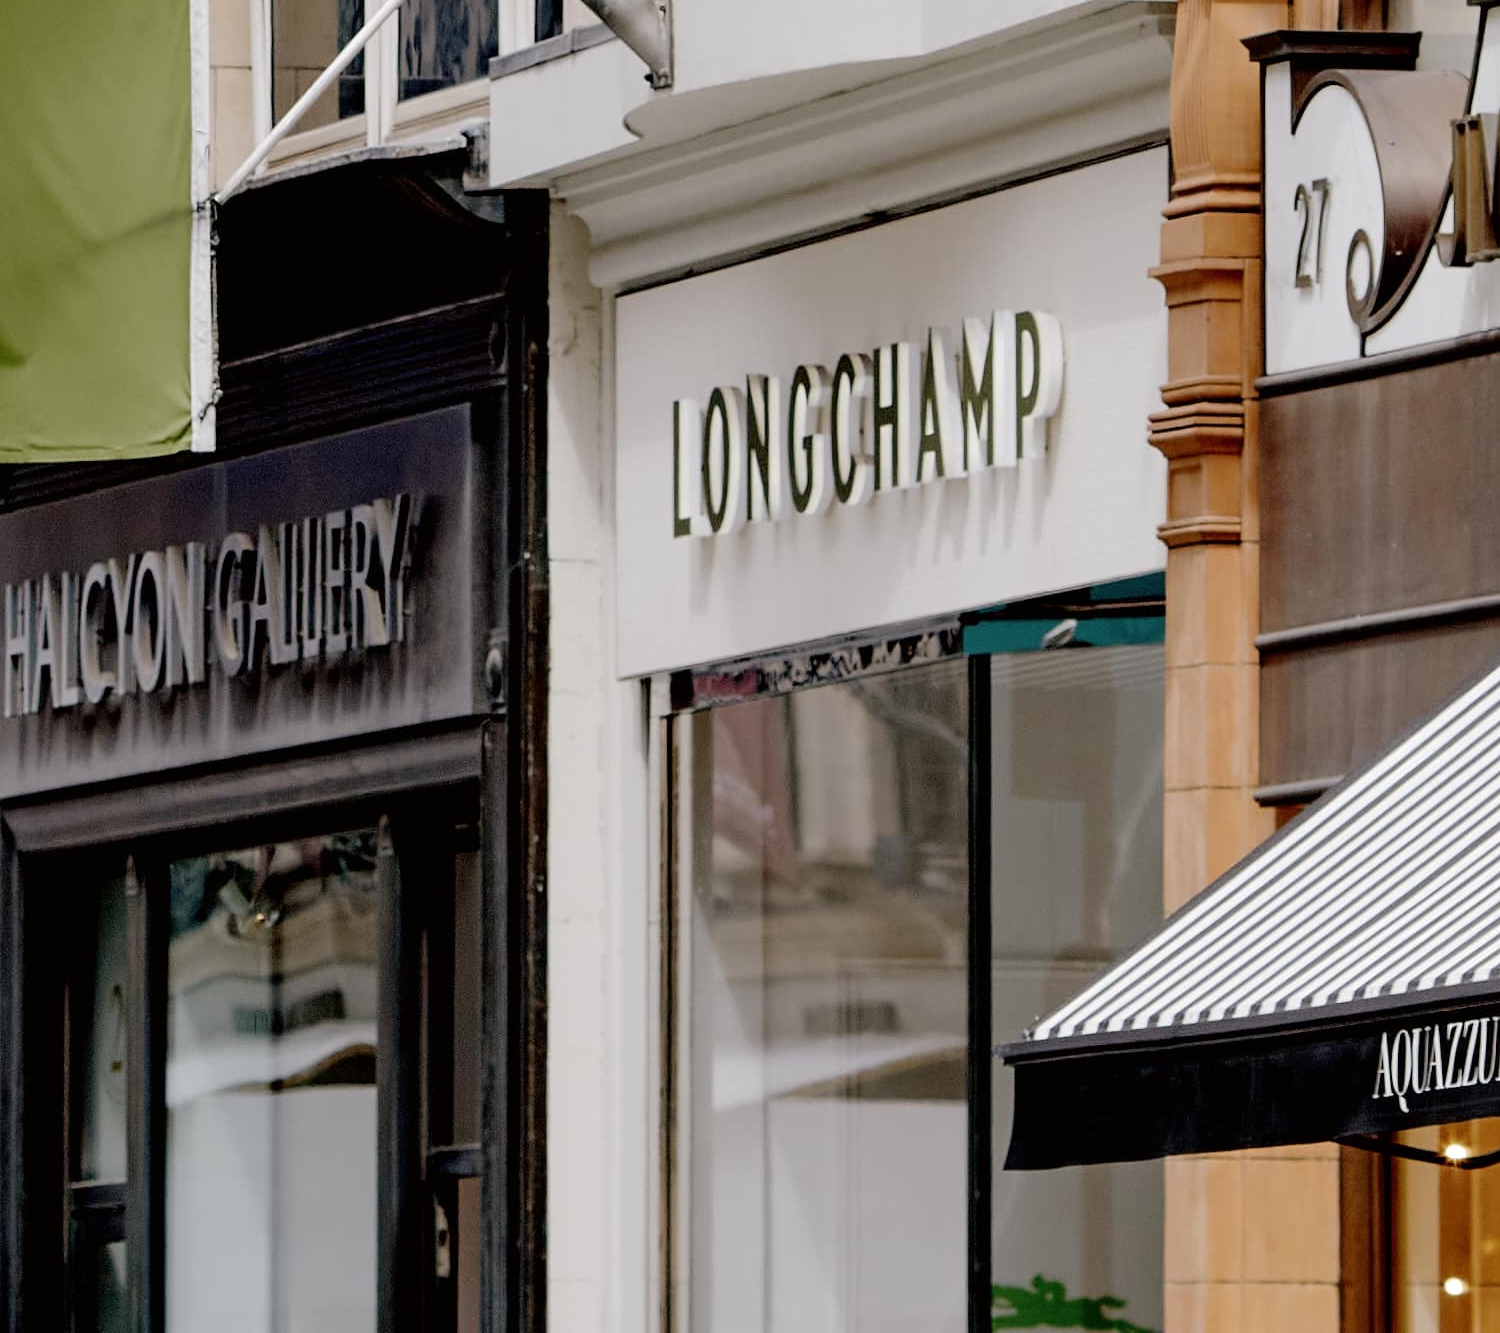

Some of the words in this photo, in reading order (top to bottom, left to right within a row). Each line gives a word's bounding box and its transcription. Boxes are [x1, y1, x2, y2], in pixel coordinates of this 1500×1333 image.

[1293, 177, 1331, 289] 27
[674, 309, 1064, 538] LONGCHAMP
[5, 541, 207, 718] HALCYON
[213, 493, 412, 678] GALLERY
